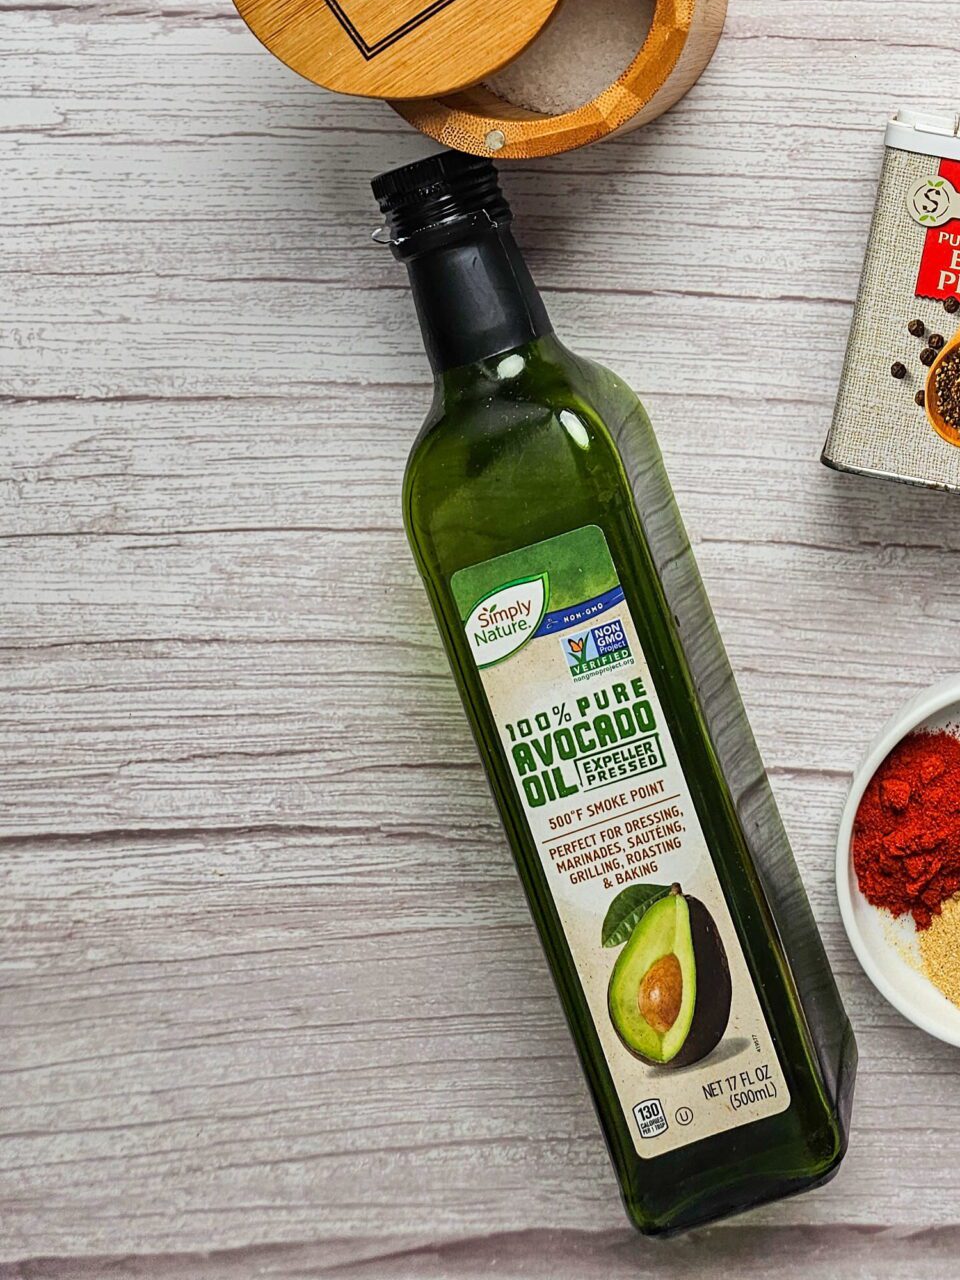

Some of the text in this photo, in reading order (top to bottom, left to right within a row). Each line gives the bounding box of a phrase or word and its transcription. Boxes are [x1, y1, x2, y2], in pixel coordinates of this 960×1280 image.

[478, 600, 531, 628] Simply
[563, 603, 604, 623] NON-GMO
[594, 622, 621, 638] NON
[597, 631, 624, 647] GMO
[573, 649, 629, 674] VERIFIED
[599, 640, 626, 654] Project
[573, 658, 635, 683] nongmoproject.org
[505, 677, 647, 742] 100% PURE
[511, 699, 657, 776] AVOCADO
[582, 741, 655, 775] EXPELLER
[586, 753, 658, 787] PRESSED
[522, 766, 579, 808] OIL
[549, 780, 665, 830] 500°F SMOKE POINT
[549, 805, 684, 860] PERFECT FOR DRESSING,
[556, 820, 686, 874] MARINADES, SAUTÉING,
[569, 837, 682, 885] GRILLING, ROASTING
[602, 861, 658, 889] & BAKING
[702, 1064, 772, 1100] NET 17 FL OZ
[729, 1081, 777, 1111] (500mL)
[638, 1102, 660, 1121] 130
[640, 1116, 664, 1130] CALORIES
